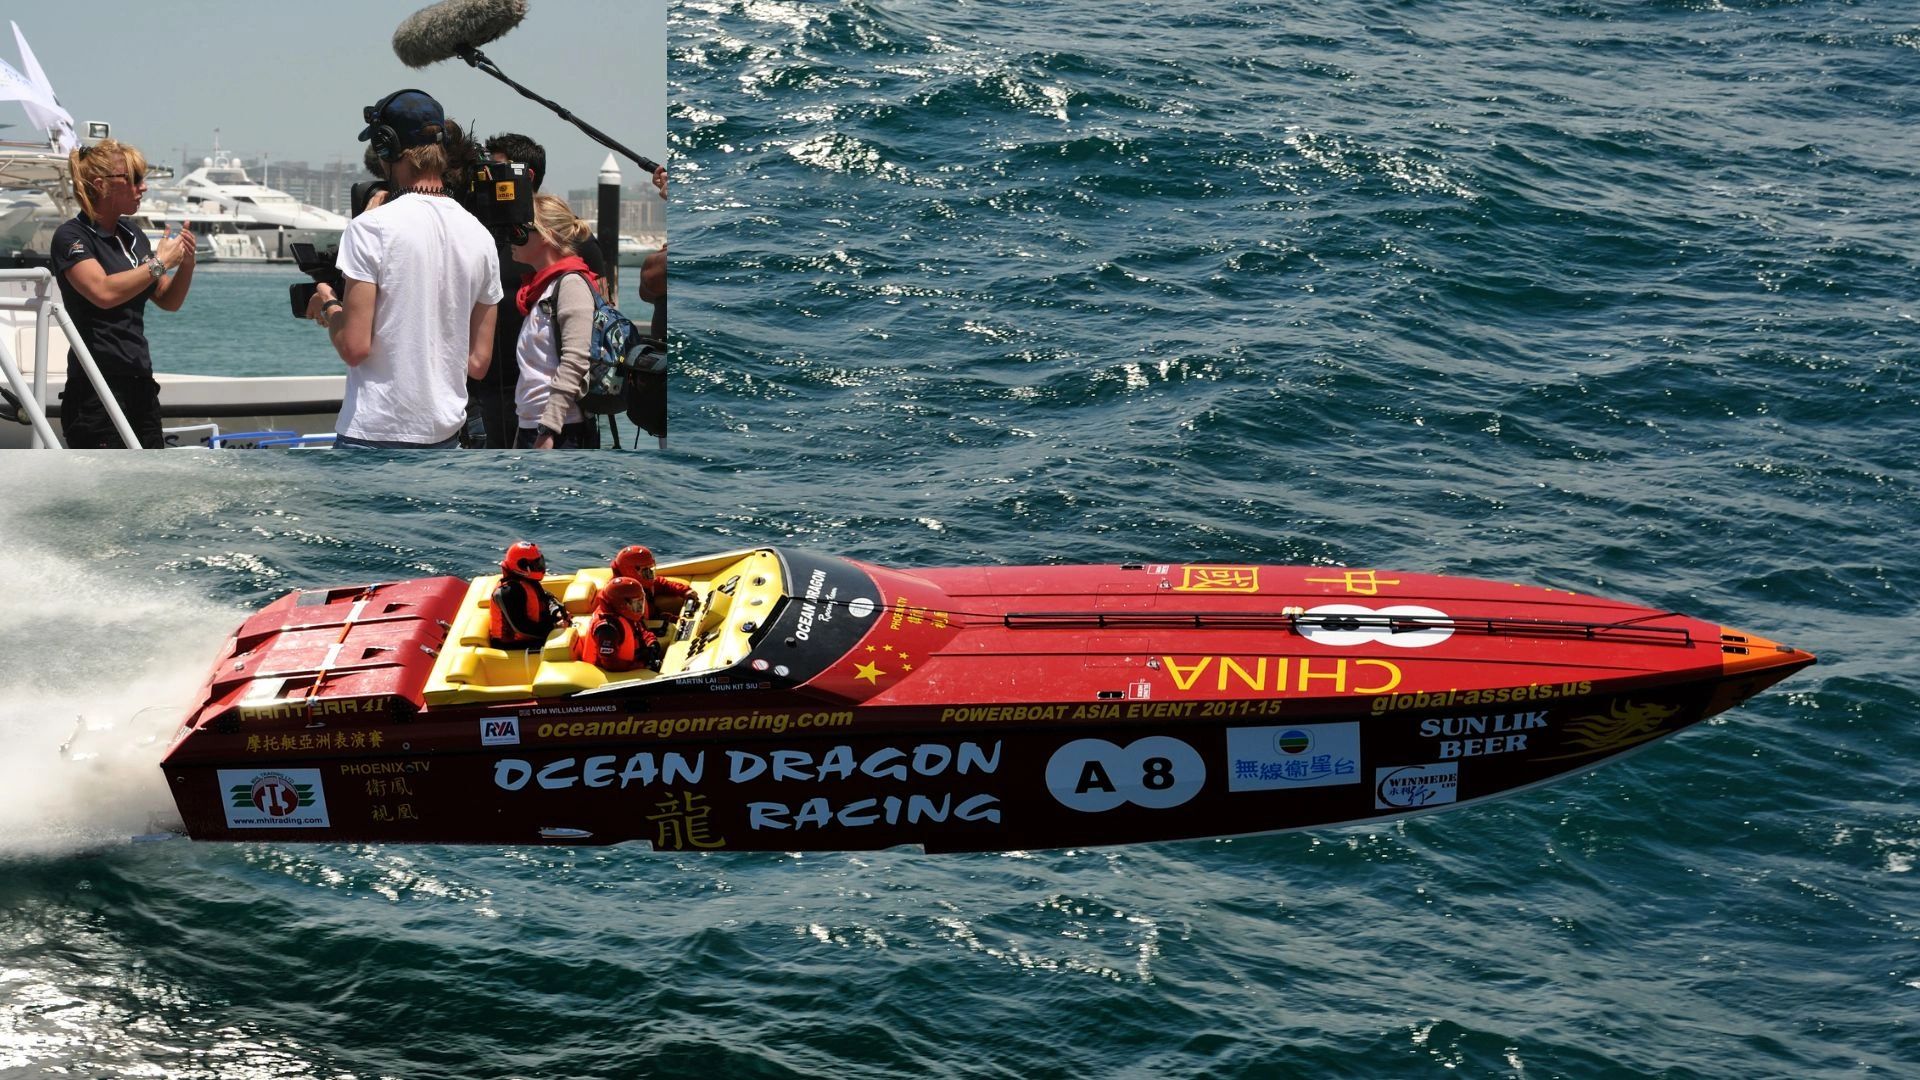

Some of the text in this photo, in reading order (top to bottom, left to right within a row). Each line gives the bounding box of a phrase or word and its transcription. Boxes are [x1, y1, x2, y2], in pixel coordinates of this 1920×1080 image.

[795, 569, 827, 640] OCEAN DRAGON
[675, 676, 717, 685] MARTIN LAI
[710, 683, 732, 692] CHUN
[1162, 656, 1402, 693] CHINA
[239, 700, 358, 721] PANTERA
[548, 705, 617, 714] WILLIAMS-HAWKES
[941, 700, 1281, 722] POWERBOAT ASIA EVENT 2011-15
[1371, 680, 1592, 716] global-assets.us
[485, 721, 515, 737] RYA
[537, 709, 853, 739] oceandragonracing.com
[1419, 710, 1549, 738] SUN LIK
[1439, 734, 1528, 759] BEER
[340, 760, 431, 775] PHOENIX TV
[494, 740, 1001, 791] OCEAN DRAGON
[1075, 756, 1176, 794] A 8
[1234, 753, 1355, 781] 無線衛星台
[1389, 773, 1457, 787] WINMEDE
[233, 817, 323, 825] www.mhitrading.com
[646, 791, 726, 852] 龍
[746, 793, 1001, 832] RACING
